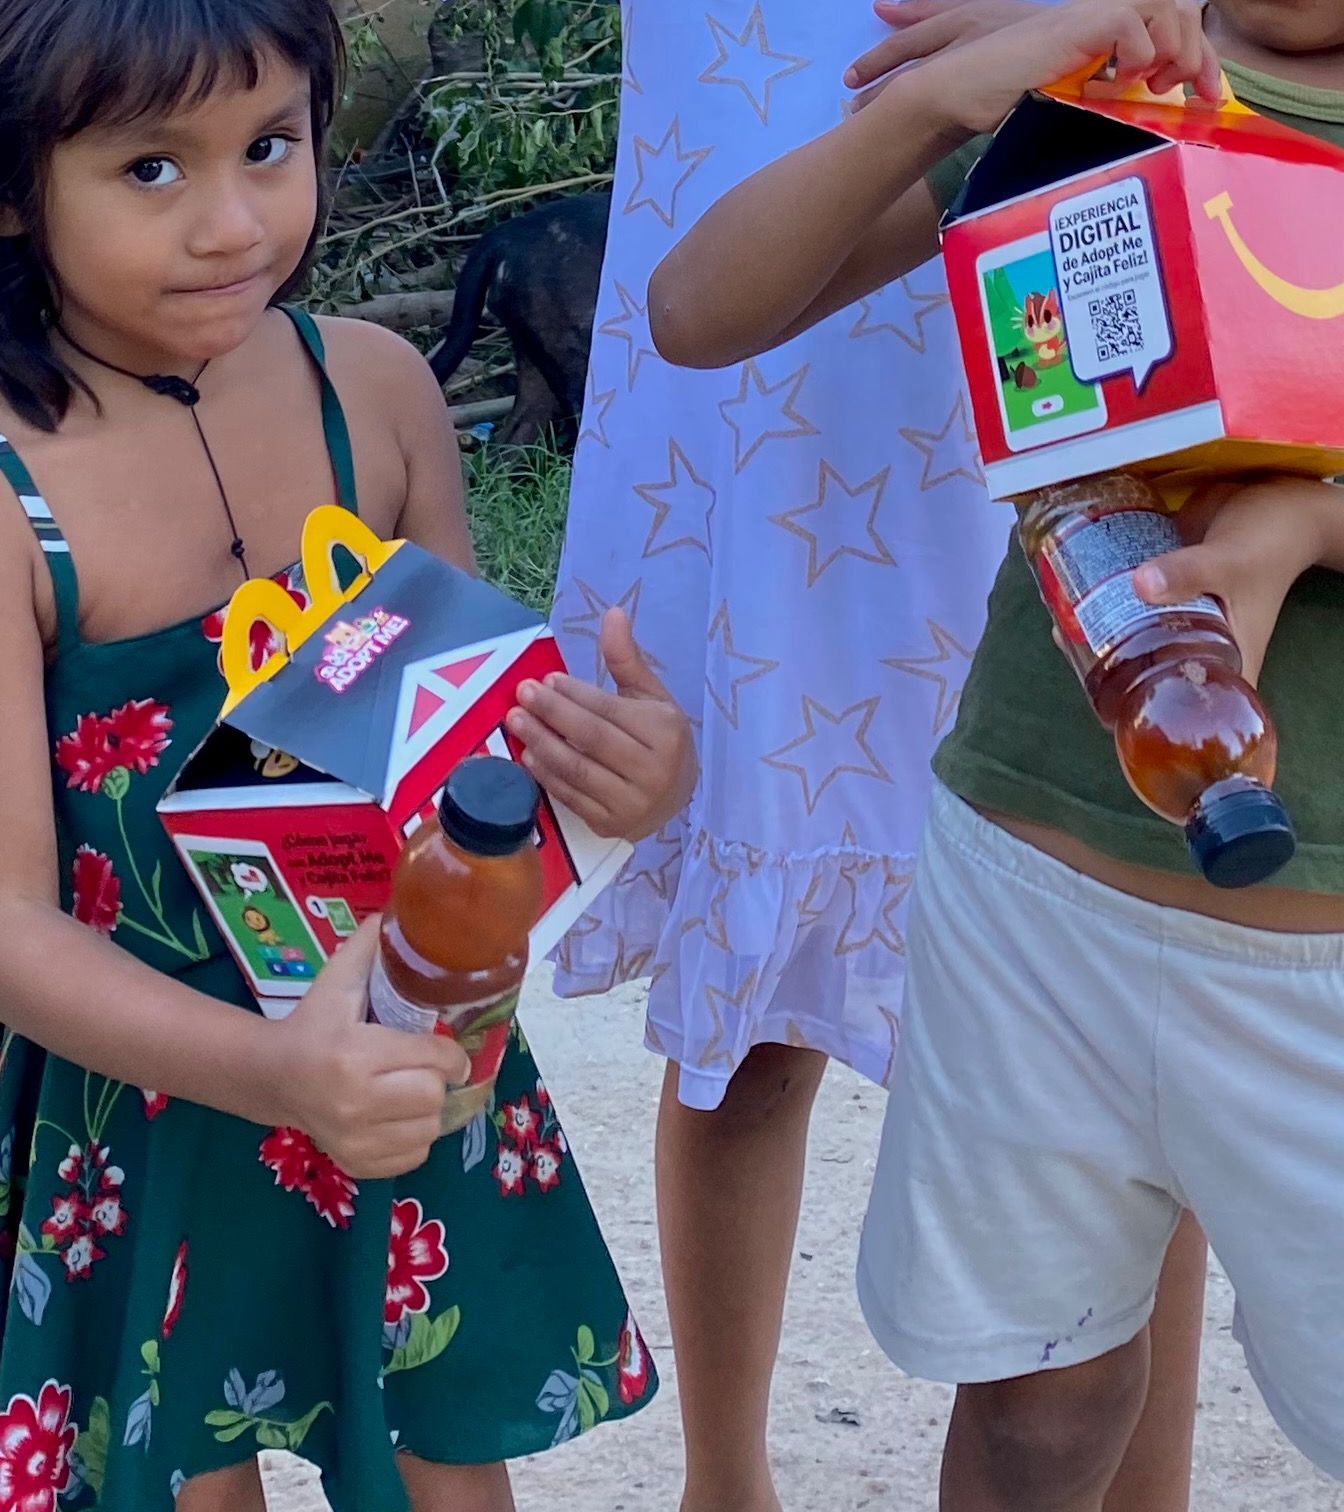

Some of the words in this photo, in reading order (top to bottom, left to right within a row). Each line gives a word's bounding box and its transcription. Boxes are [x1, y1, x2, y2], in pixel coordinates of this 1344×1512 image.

[1054, 193, 1139, 232] ¡EXPERIENCIA
[1059, 210, 1141, 254] DIGITAL
[1062, 256, 1079, 272] de
[1081, 242, 1121, 267] Adopt
[1122, 236, 1143, 253] Me
[1062, 276, 1071, 294] y
[1072, 264, 1111, 286] Cajita
[1113, 249, 1149, 273] Feliz!
[328, 640, 382, 692] ADOPT
[372, 615, 409, 646] ME!
[306, 850, 356, 869] Adopt
[357, 849, 385, 865] Me
[311, 900, 322, 914] 1
